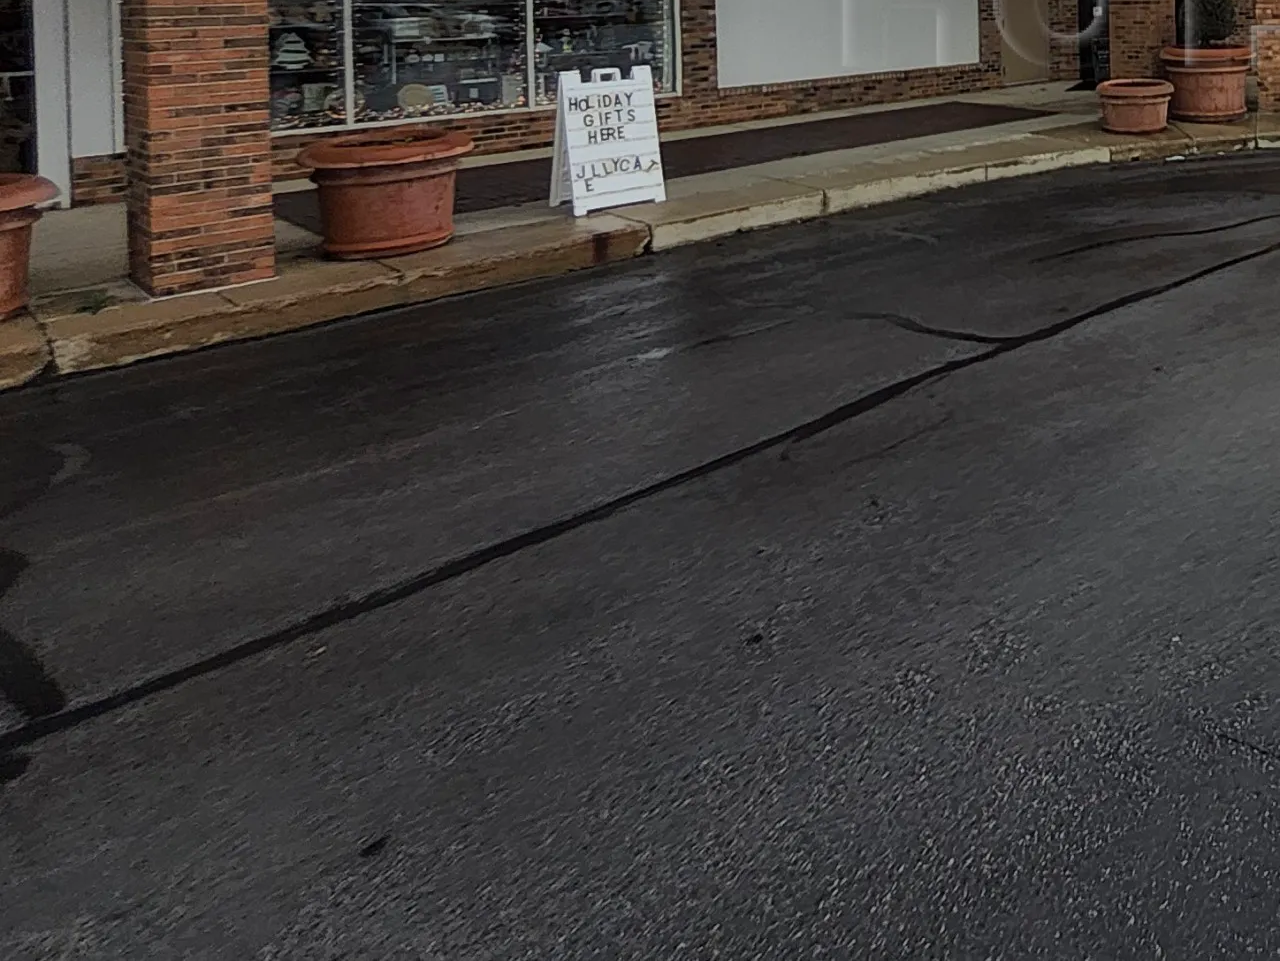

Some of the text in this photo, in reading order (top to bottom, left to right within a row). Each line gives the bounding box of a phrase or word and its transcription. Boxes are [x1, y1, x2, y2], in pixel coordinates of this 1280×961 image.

[568, 92, 633, 112] HOLIDAY
[583, 109, 636, 127] GIFTS
[587, 126, 626, 145] HERE
